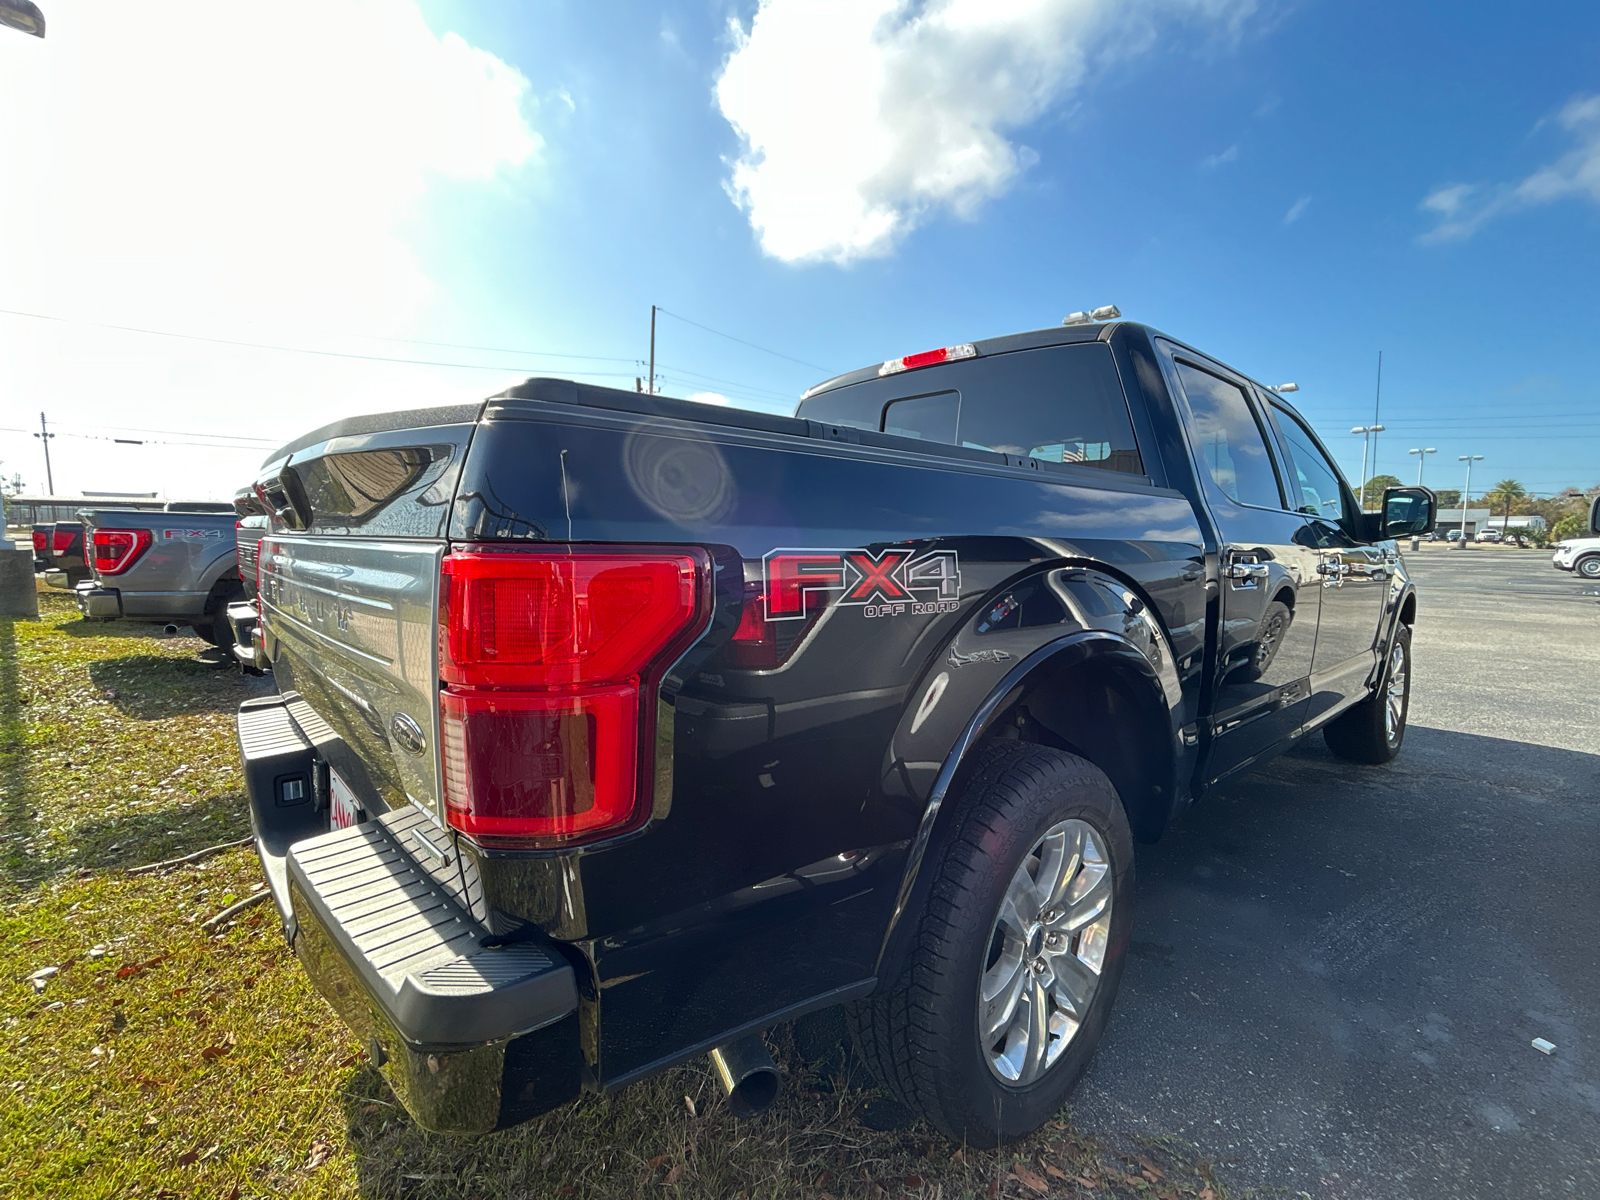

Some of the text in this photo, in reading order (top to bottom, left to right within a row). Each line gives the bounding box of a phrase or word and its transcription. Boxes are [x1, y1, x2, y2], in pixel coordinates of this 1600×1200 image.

[163, 528, 225, 540] FX4
[762, 547, 961, 622] FX4
[864, 600, 960, 618] OFF ROAD
